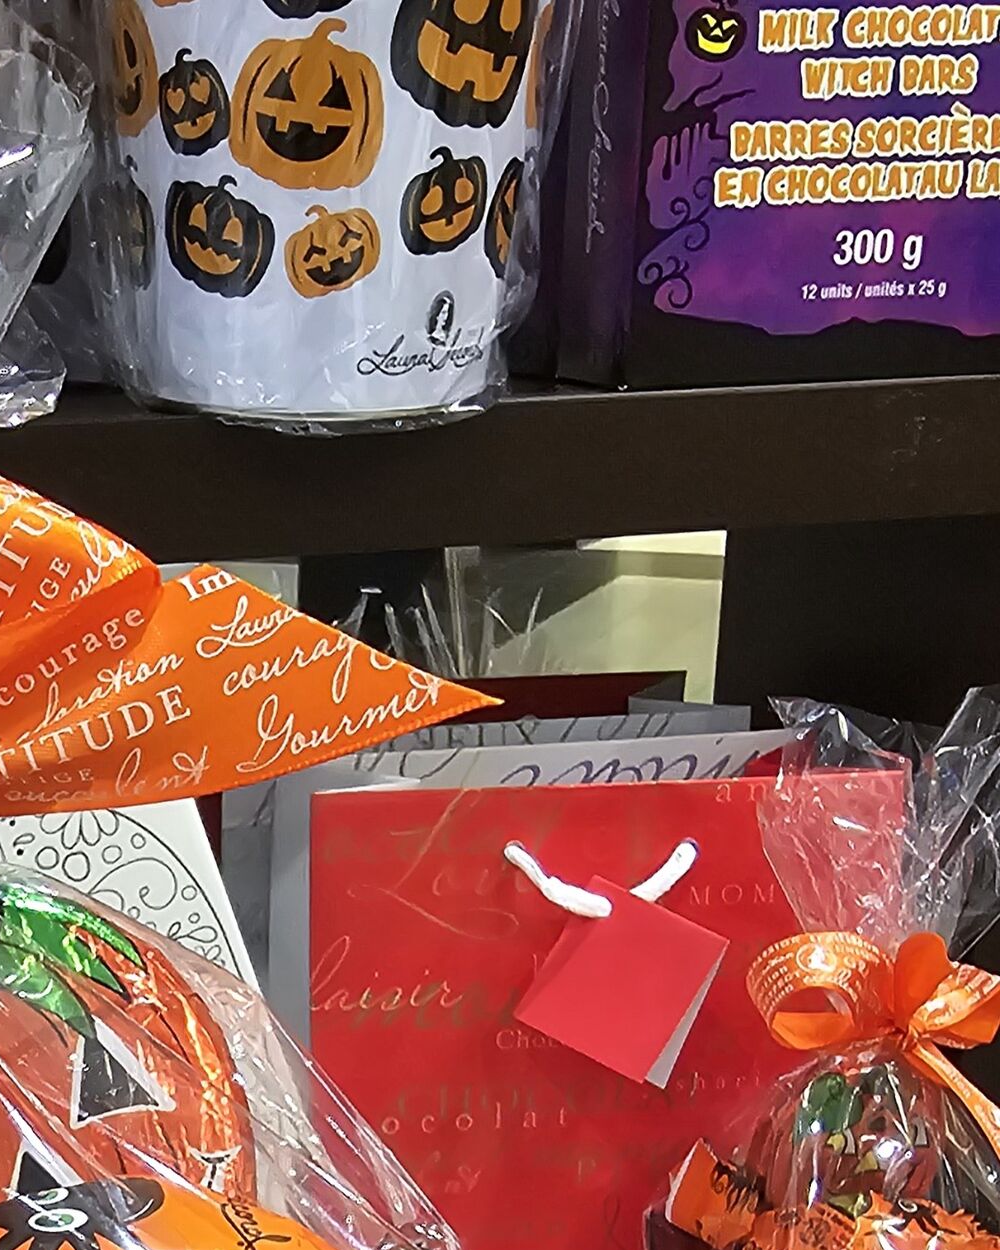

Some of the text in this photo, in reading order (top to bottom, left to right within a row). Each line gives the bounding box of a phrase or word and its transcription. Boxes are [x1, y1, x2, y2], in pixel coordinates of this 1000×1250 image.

[758, 9, 839, 53] MILK
[801, 53, 978, 100] WITCH BARS
[730, 119, 853, 162] BARRES
[714, 166, 764, 208] EN
[833, 228, 923, 270] 300 g
[801, 283, 817, 300] 12
[820, 283, 852, 299] units
[864, 280, 904, 298] unités
[918, 279, 935, 296] 25
[938, 281, 947, 298] g
[356, 333, 429, 376] Laura
[235, 669, 446, 773] Gourmet
[311, 936, 464, 1012] laisir
